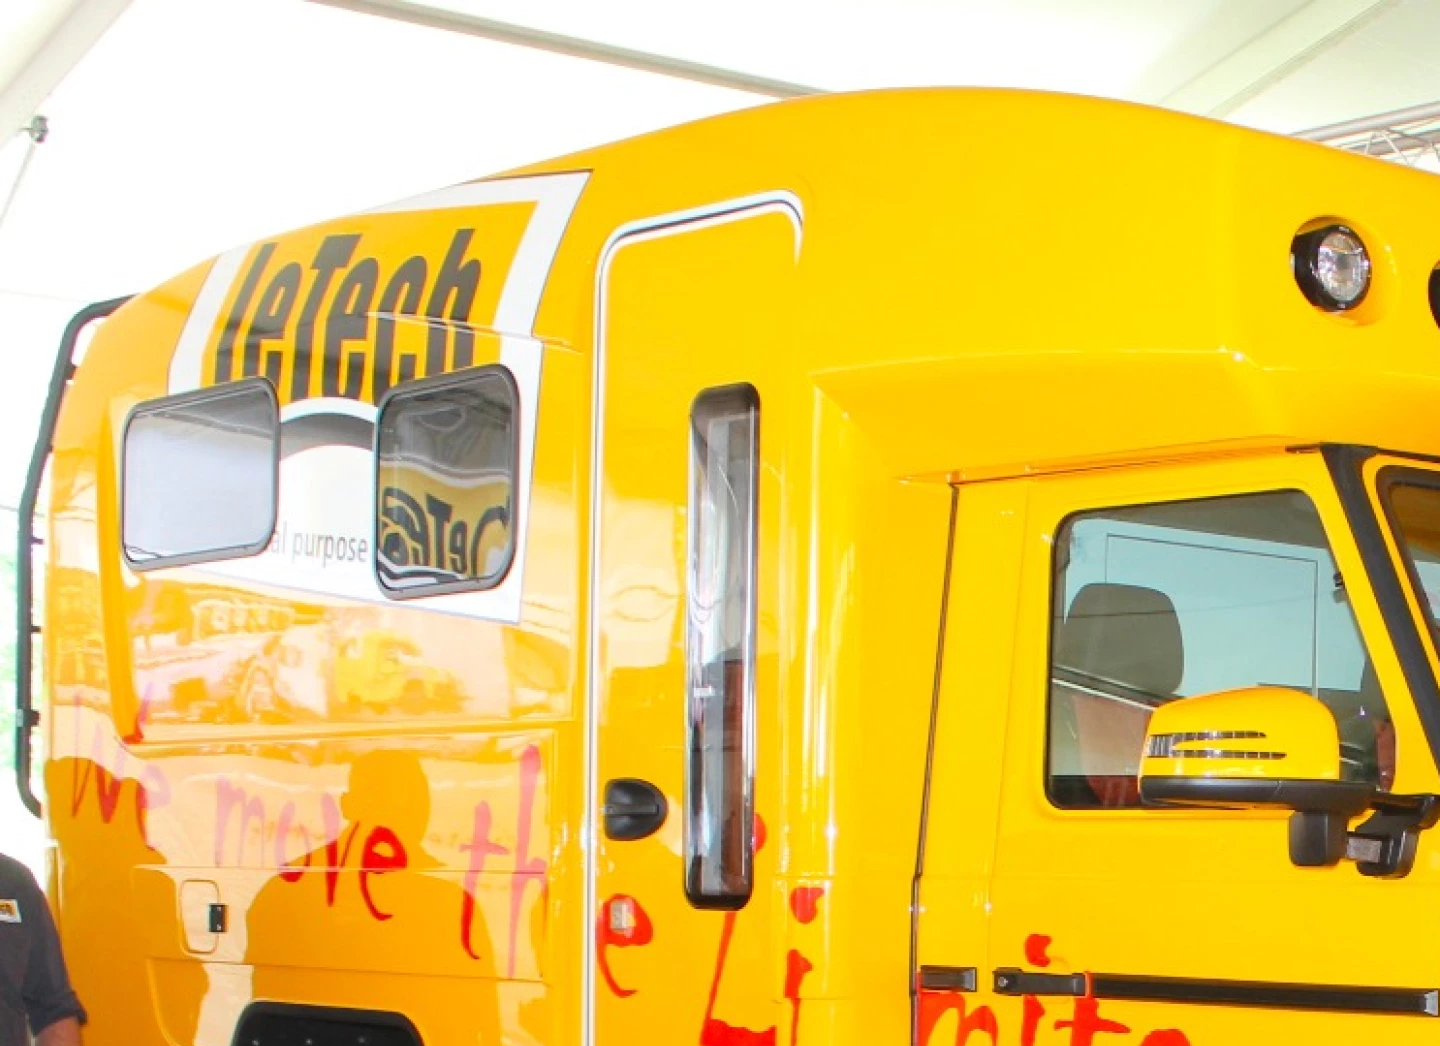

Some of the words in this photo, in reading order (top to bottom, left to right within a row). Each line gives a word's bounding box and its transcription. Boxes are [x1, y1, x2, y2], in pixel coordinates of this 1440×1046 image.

[291, 532, 369, 569] purpose
[214, 776, 408, 921] move
[458, 743, 654, 998] the
